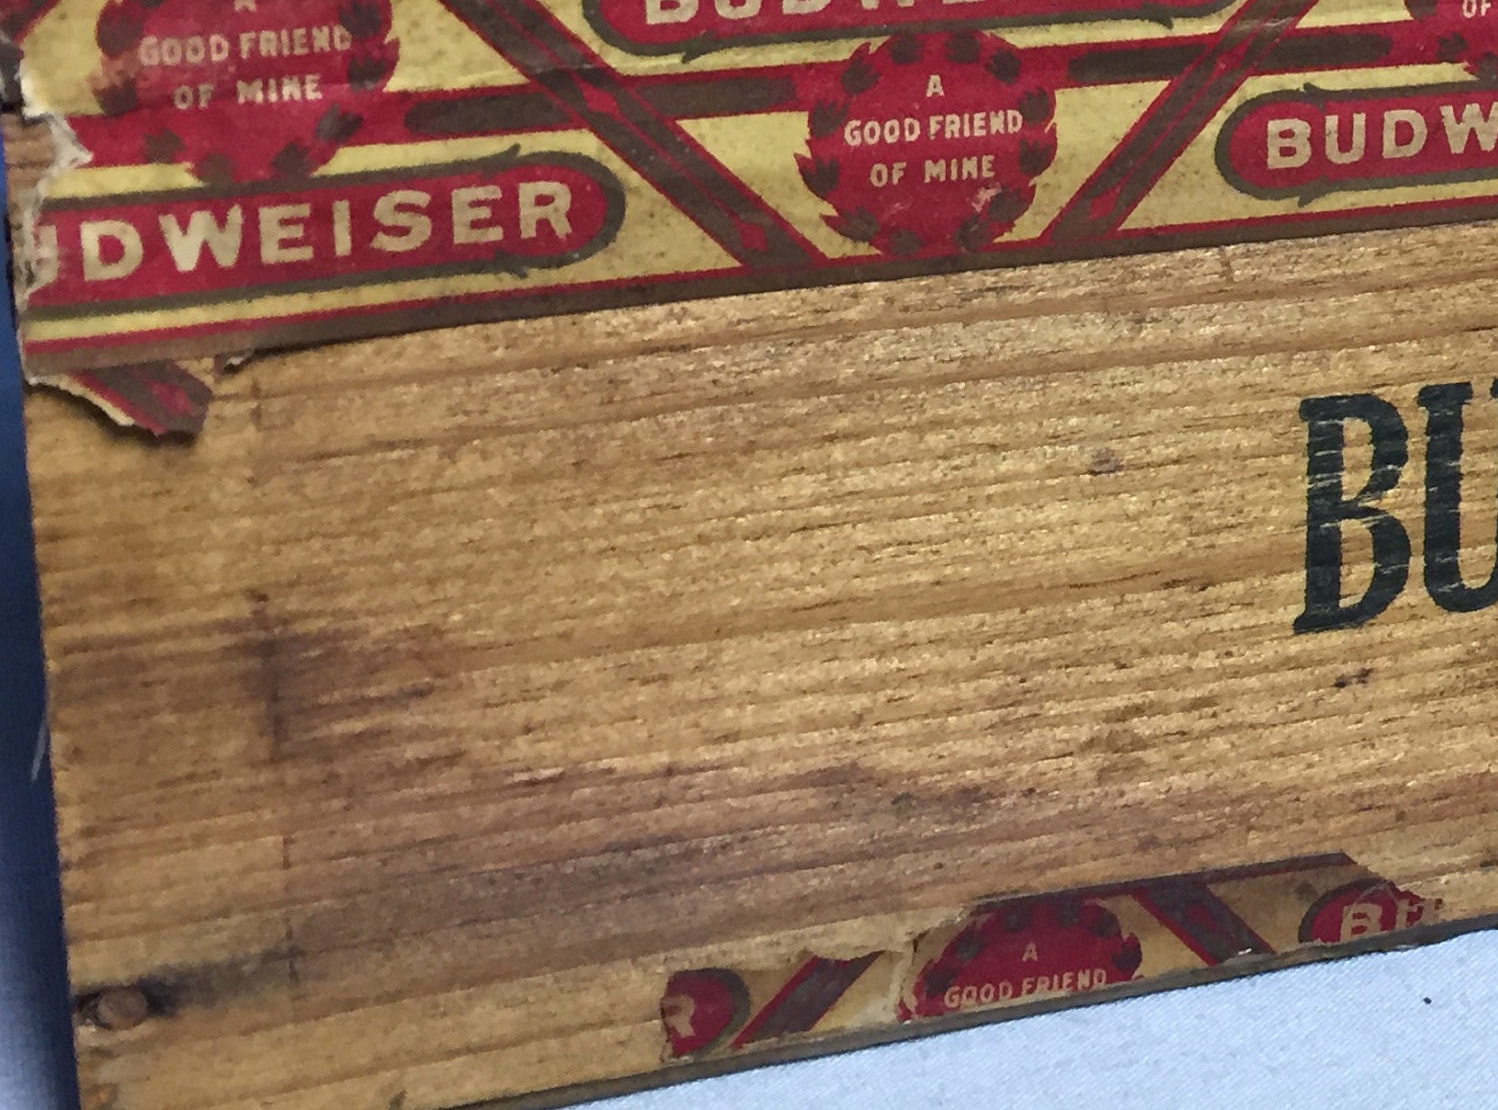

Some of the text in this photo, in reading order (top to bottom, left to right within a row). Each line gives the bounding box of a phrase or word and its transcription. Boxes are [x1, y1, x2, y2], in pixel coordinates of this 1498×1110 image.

[138, 25, 352, 66] GOOD FRIEND
[173, 74, 324, 110] OF MINE
[926, 74, 945, 98] A
[844, 109, 1024, 147] GOOD FRIEND
[869, 154, 996, 188] OF MINE
[1021, 942, 1038, 962] A
[944, 968, 1107, 1008] GOOD FRIEND
